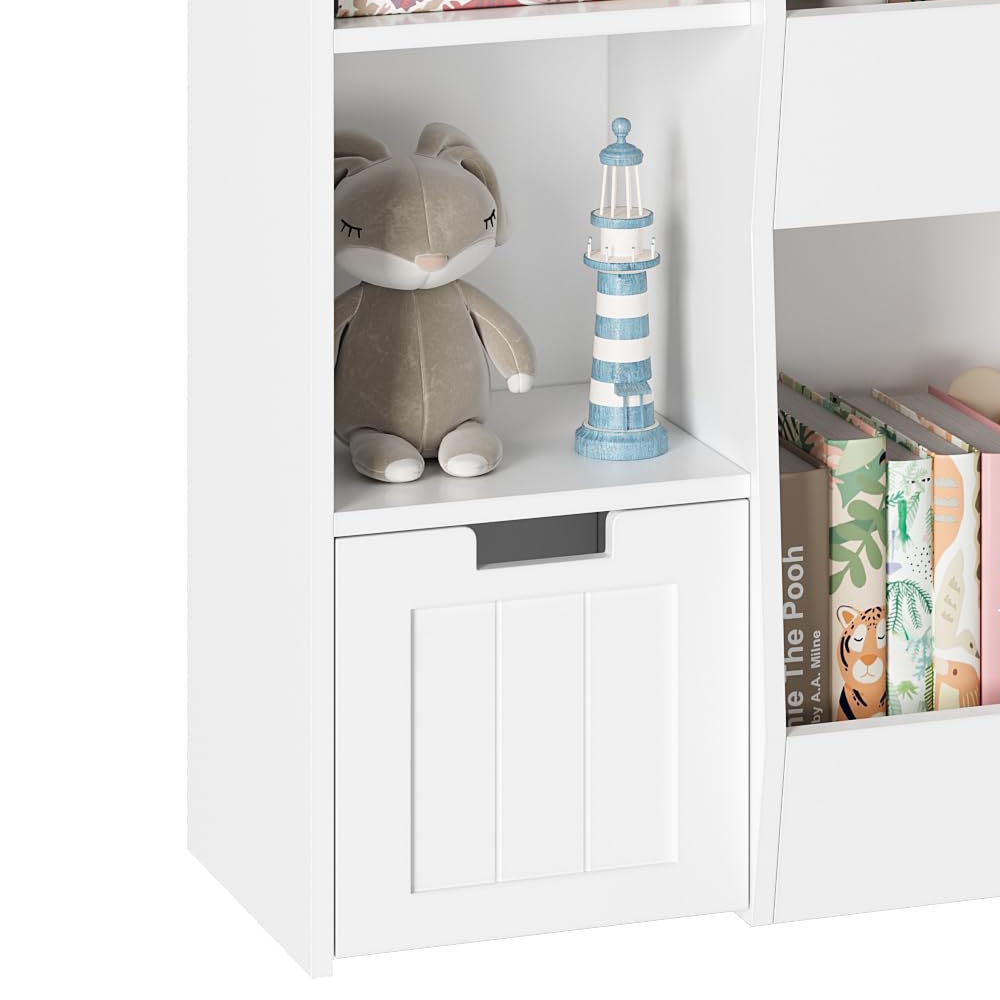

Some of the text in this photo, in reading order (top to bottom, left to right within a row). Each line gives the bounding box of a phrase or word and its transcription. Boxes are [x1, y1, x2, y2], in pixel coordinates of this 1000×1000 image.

[782, 545, 804, 619] Pooh
[784, 629, 804, 683] The
[810, 630, 823, 724] by A.A. Milne
